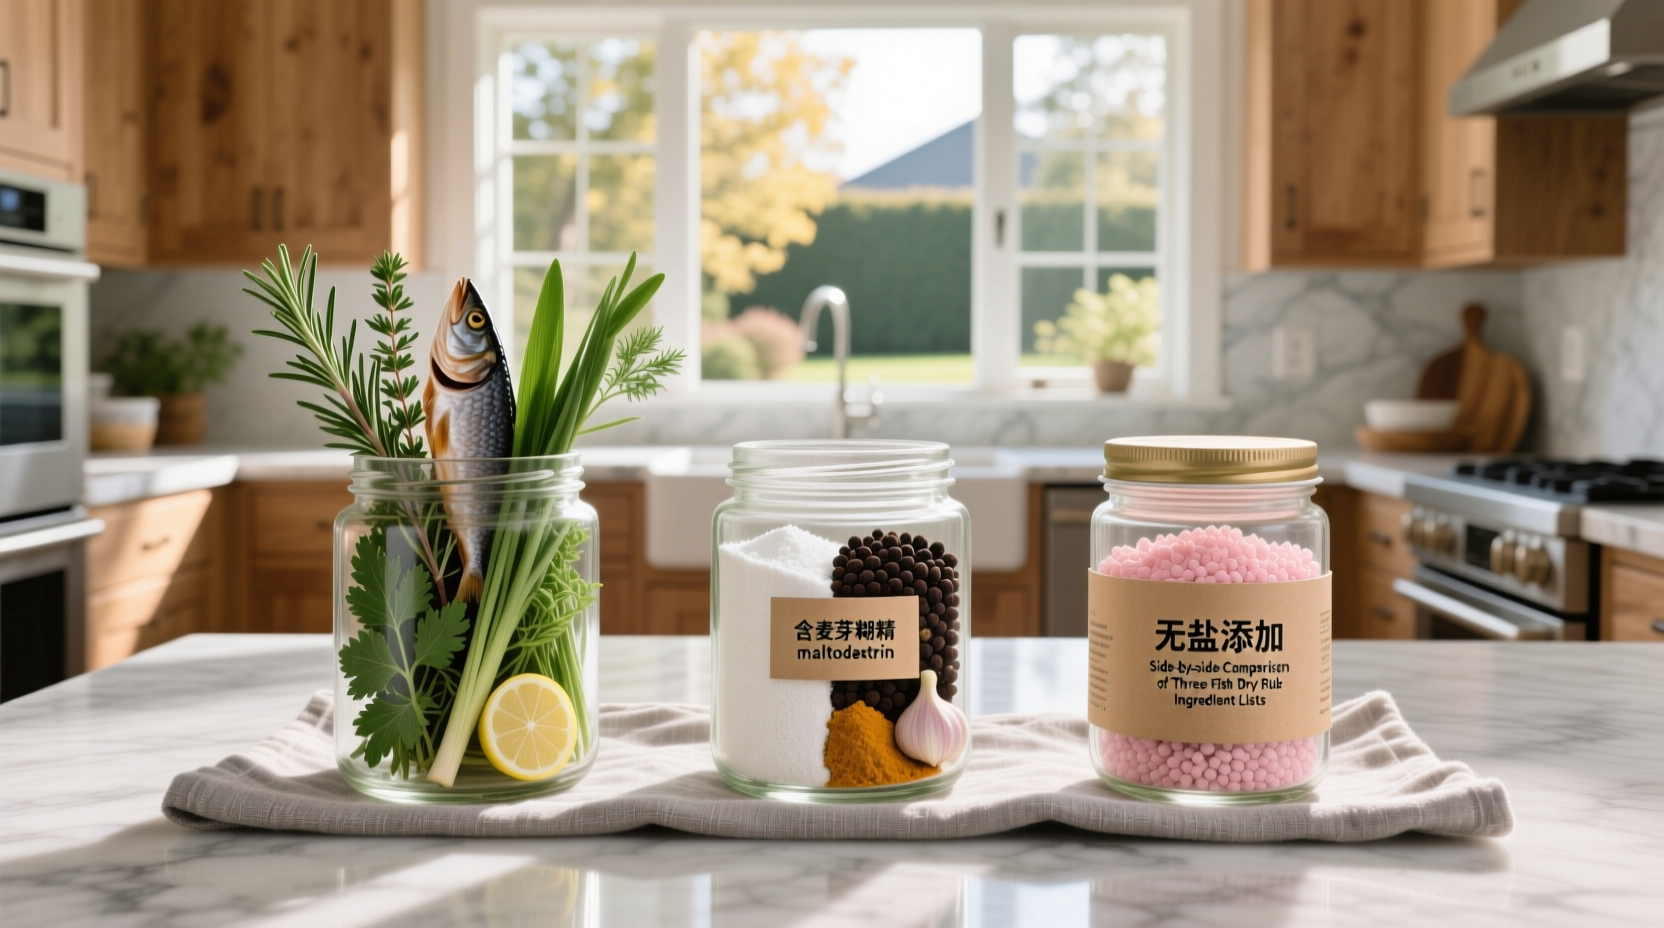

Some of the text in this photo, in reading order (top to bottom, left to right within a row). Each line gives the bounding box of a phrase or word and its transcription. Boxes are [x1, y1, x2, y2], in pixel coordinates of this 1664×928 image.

[794, 618, 896, 642] 含麦芽糊精
[1154, 618, 1283, 654] 无盐添加
[1170, 676, 1208, 690] Three
[1237, 677, 1259, 693] Dry
